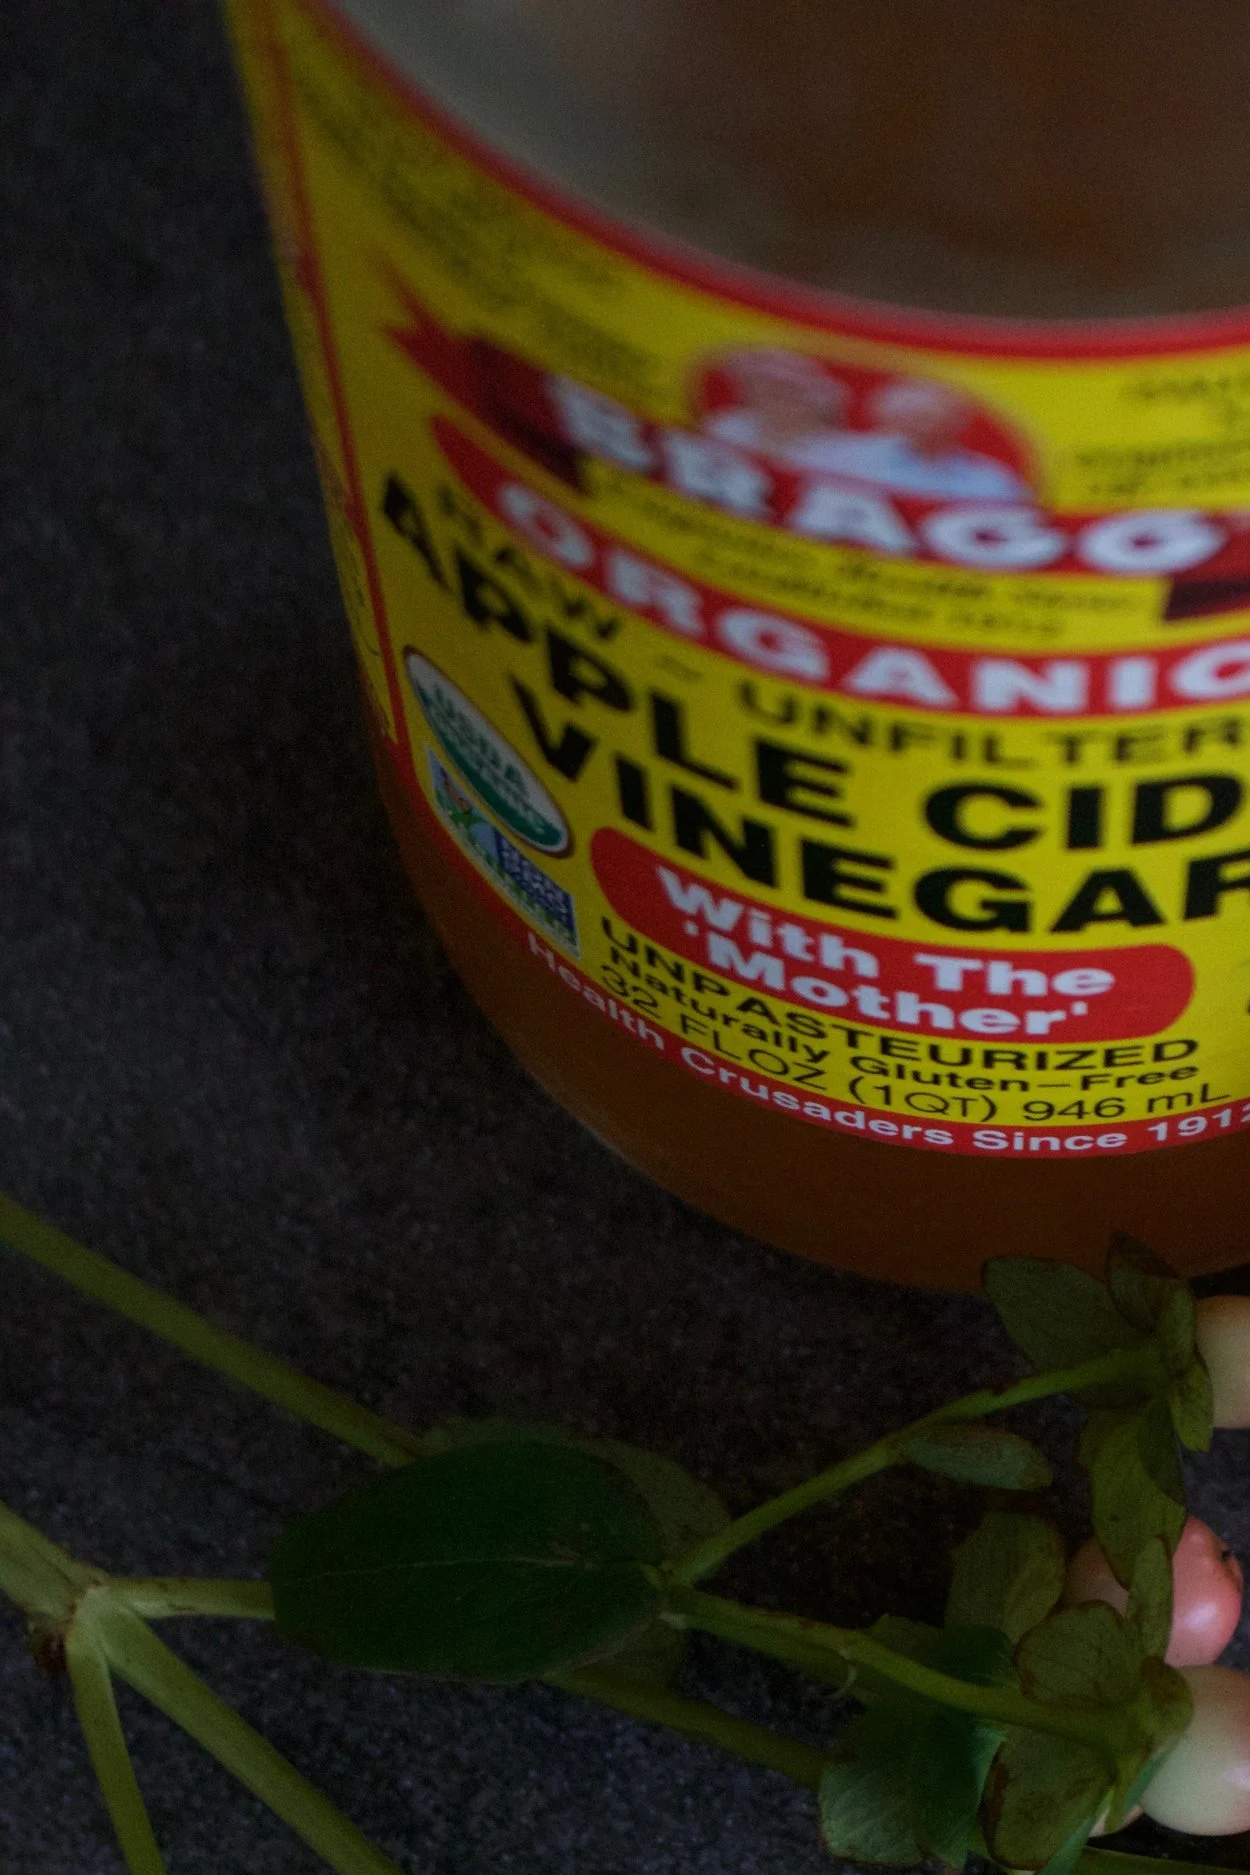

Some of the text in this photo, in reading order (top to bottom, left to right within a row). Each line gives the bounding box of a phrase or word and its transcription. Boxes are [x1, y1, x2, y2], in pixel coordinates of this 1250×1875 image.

[540, 370, 1232, 577] BRAGG
[438, 482, 620, 642] RAW
[383, 472, 856, 828] APPLE
[602, 916, 1199, 1072] UNPASTEURIZED
[611, 947, 830, 1062] Naturally
[655, 865, 880, 978] With
[913, 951, 1115, 998] The
[528, 931, 665, 1050] Health
[680, 1047, 955, 1146] Crusaders
[973, 1129, 1128, 1152] Since
[602, 964, 661, 1019] 32
[849, 1076, 997, 1123] (1QT)
[1024, 1097, 1125, 1121] 946
[1147, 1083, 1231, 1114] mL
